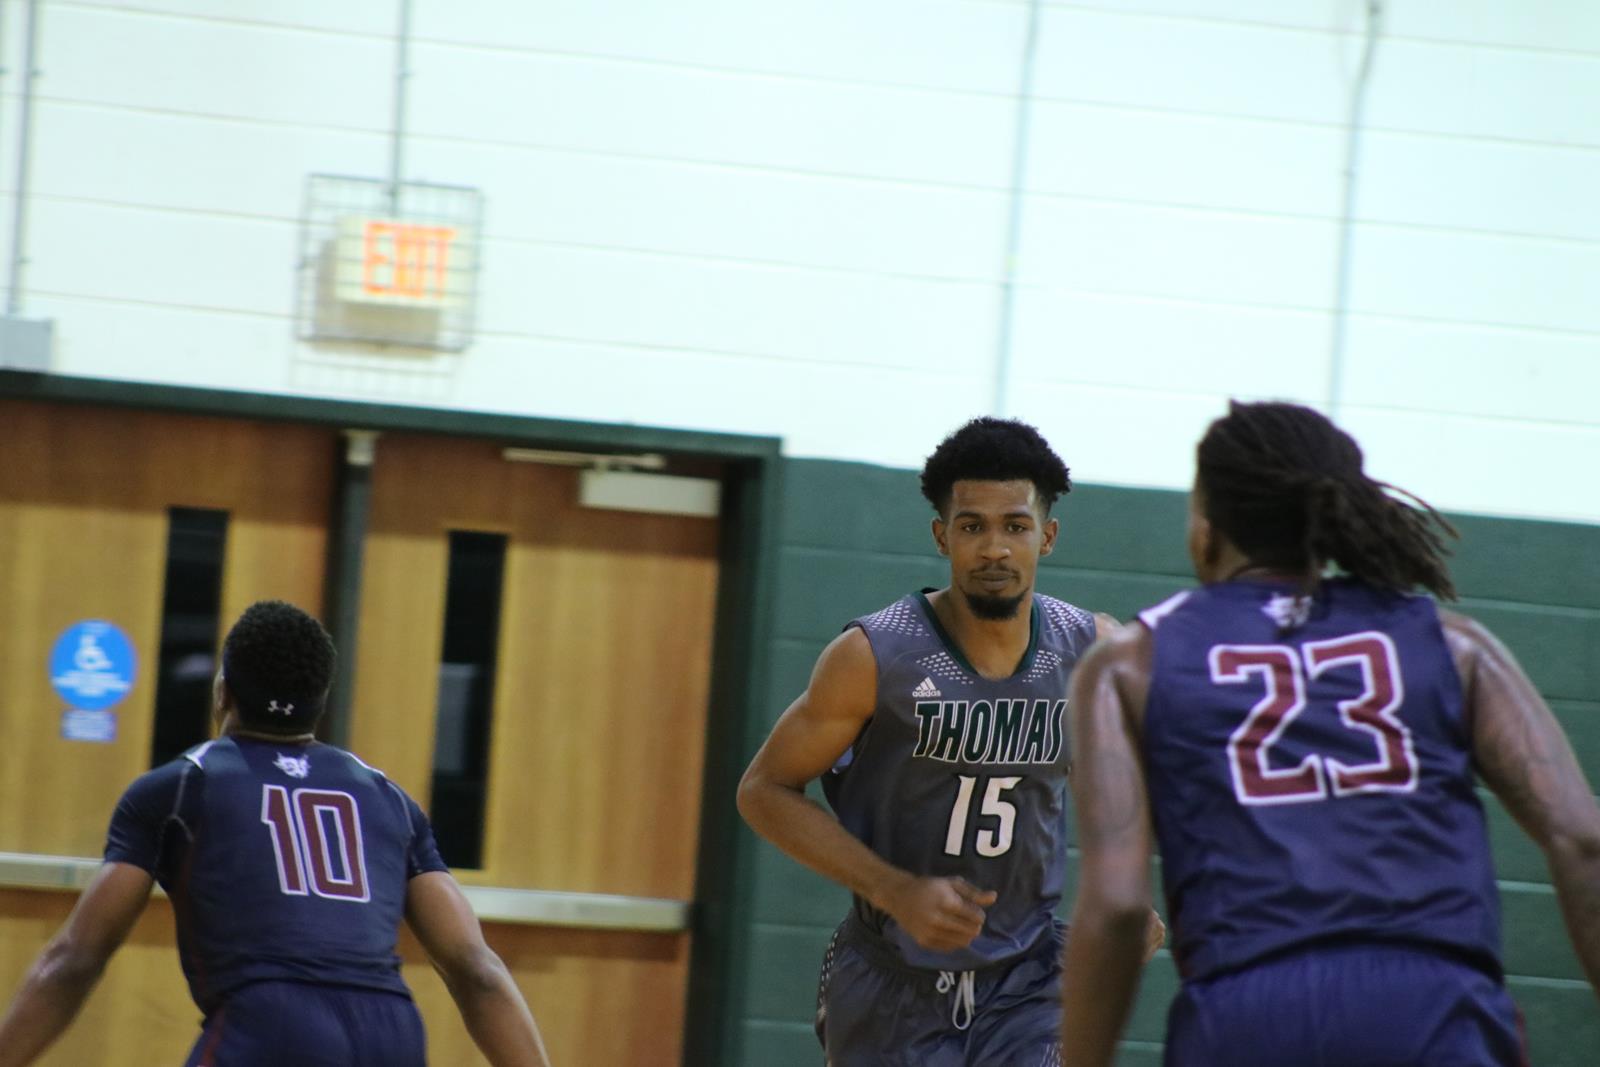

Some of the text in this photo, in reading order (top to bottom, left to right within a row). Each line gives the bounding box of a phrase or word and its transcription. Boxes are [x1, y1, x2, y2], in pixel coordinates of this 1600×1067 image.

[912, 689, 941, 697] adidas
[912, 698, 1069, 764] THOMAS
[1208, 630, 1420, 806] 23
[260, 783, 371, 903] 10
[944, 775, 1023, 857] 15
